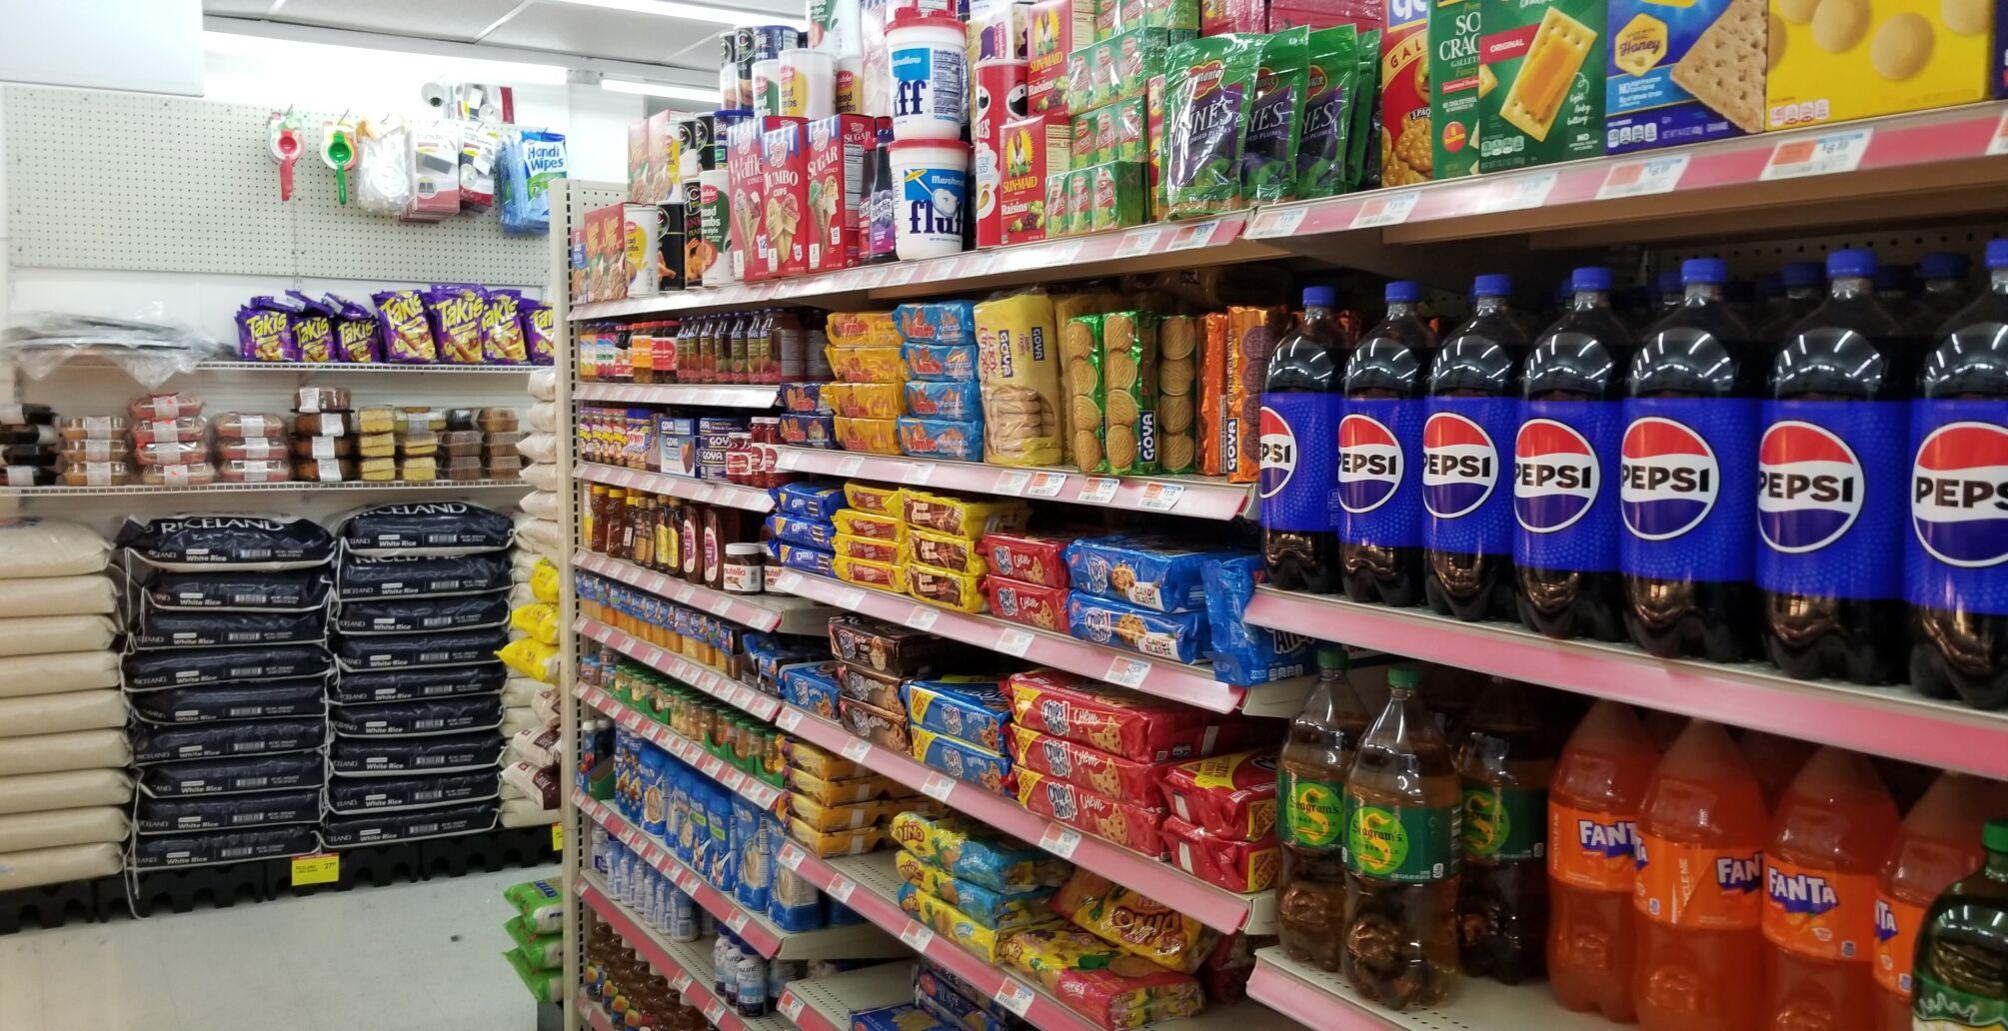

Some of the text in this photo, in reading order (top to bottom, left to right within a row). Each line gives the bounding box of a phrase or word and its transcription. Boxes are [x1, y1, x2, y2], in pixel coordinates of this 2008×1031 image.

[1490, 38, 1524, 53] ORIGINAL
[1619, 38, 1661, 56] Honey
[1029, 77, 1054, 96] Raisins
[528, 145, 560, 159] Handi
[530, 157, 564, 171] Wipes
[808, 146, 838, 180] SUGAR
[764, 170, 798, 196] JUMBO
[1001, 202, 1028, 216] Raisins
[436, 297, 484, 329] Takis
[483, 295, 518, 331] akis
[246, 313, 286, 341] Takis
[293, 317, 329, 343] Takis
[338, 319, 373, 343] Takis
[1033, 328, 1043, 360] GOYA
[1142, 413, 1152, 458] GOYA
[1228, 420, 1236, 470] GOYA
[702, 450, 724, 460] GOYA
[210, 554, 227, 562] Rice
[724, 568, 746, 576] nutella
[180, 598, 221, 606] White Rice
[1145, 645, 1172, 656] BLASTS
[370, 660, 392, 668] White
[397, 692, 412, 700] Rice
[366, 726, 387, 734] White
[366, 762, 388, 770] White
[360, 834, 382, 842] White
[1768, 866, 1838, 904] FANTA
